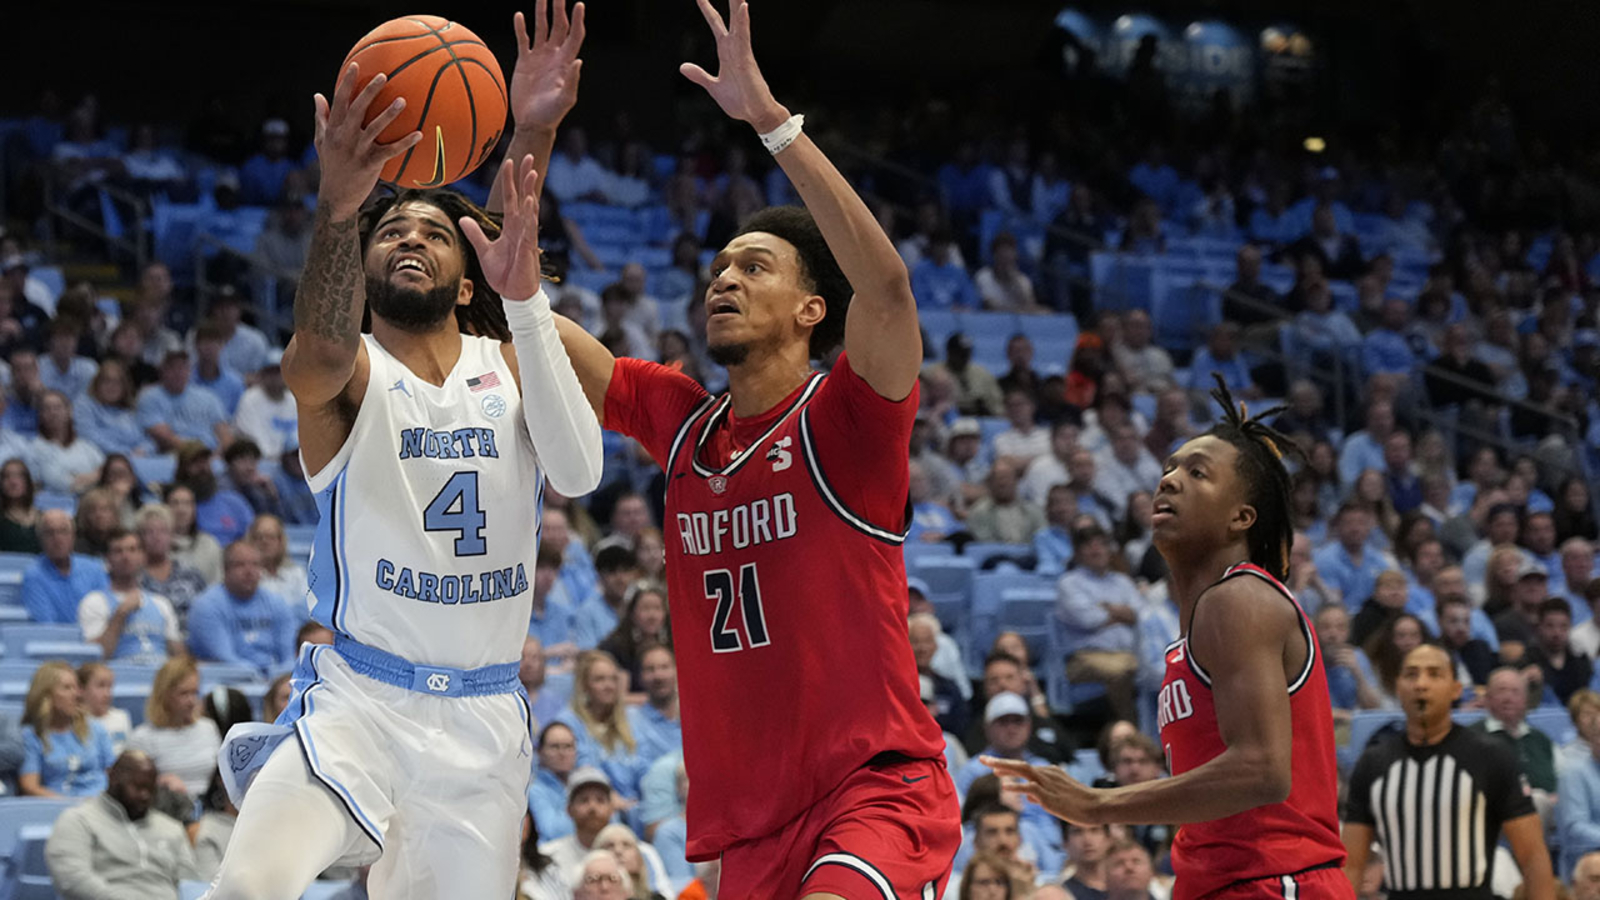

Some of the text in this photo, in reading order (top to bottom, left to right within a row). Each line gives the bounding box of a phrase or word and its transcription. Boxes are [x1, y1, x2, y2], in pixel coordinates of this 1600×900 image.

[399, 427, 499, 460] NORTH
[423, 471, 487, 557] 4
[676, 492, 798, 555] RDFORD
[375, 558, 529, 605] CAROLINA
[703, 562, 771, 653] 21
